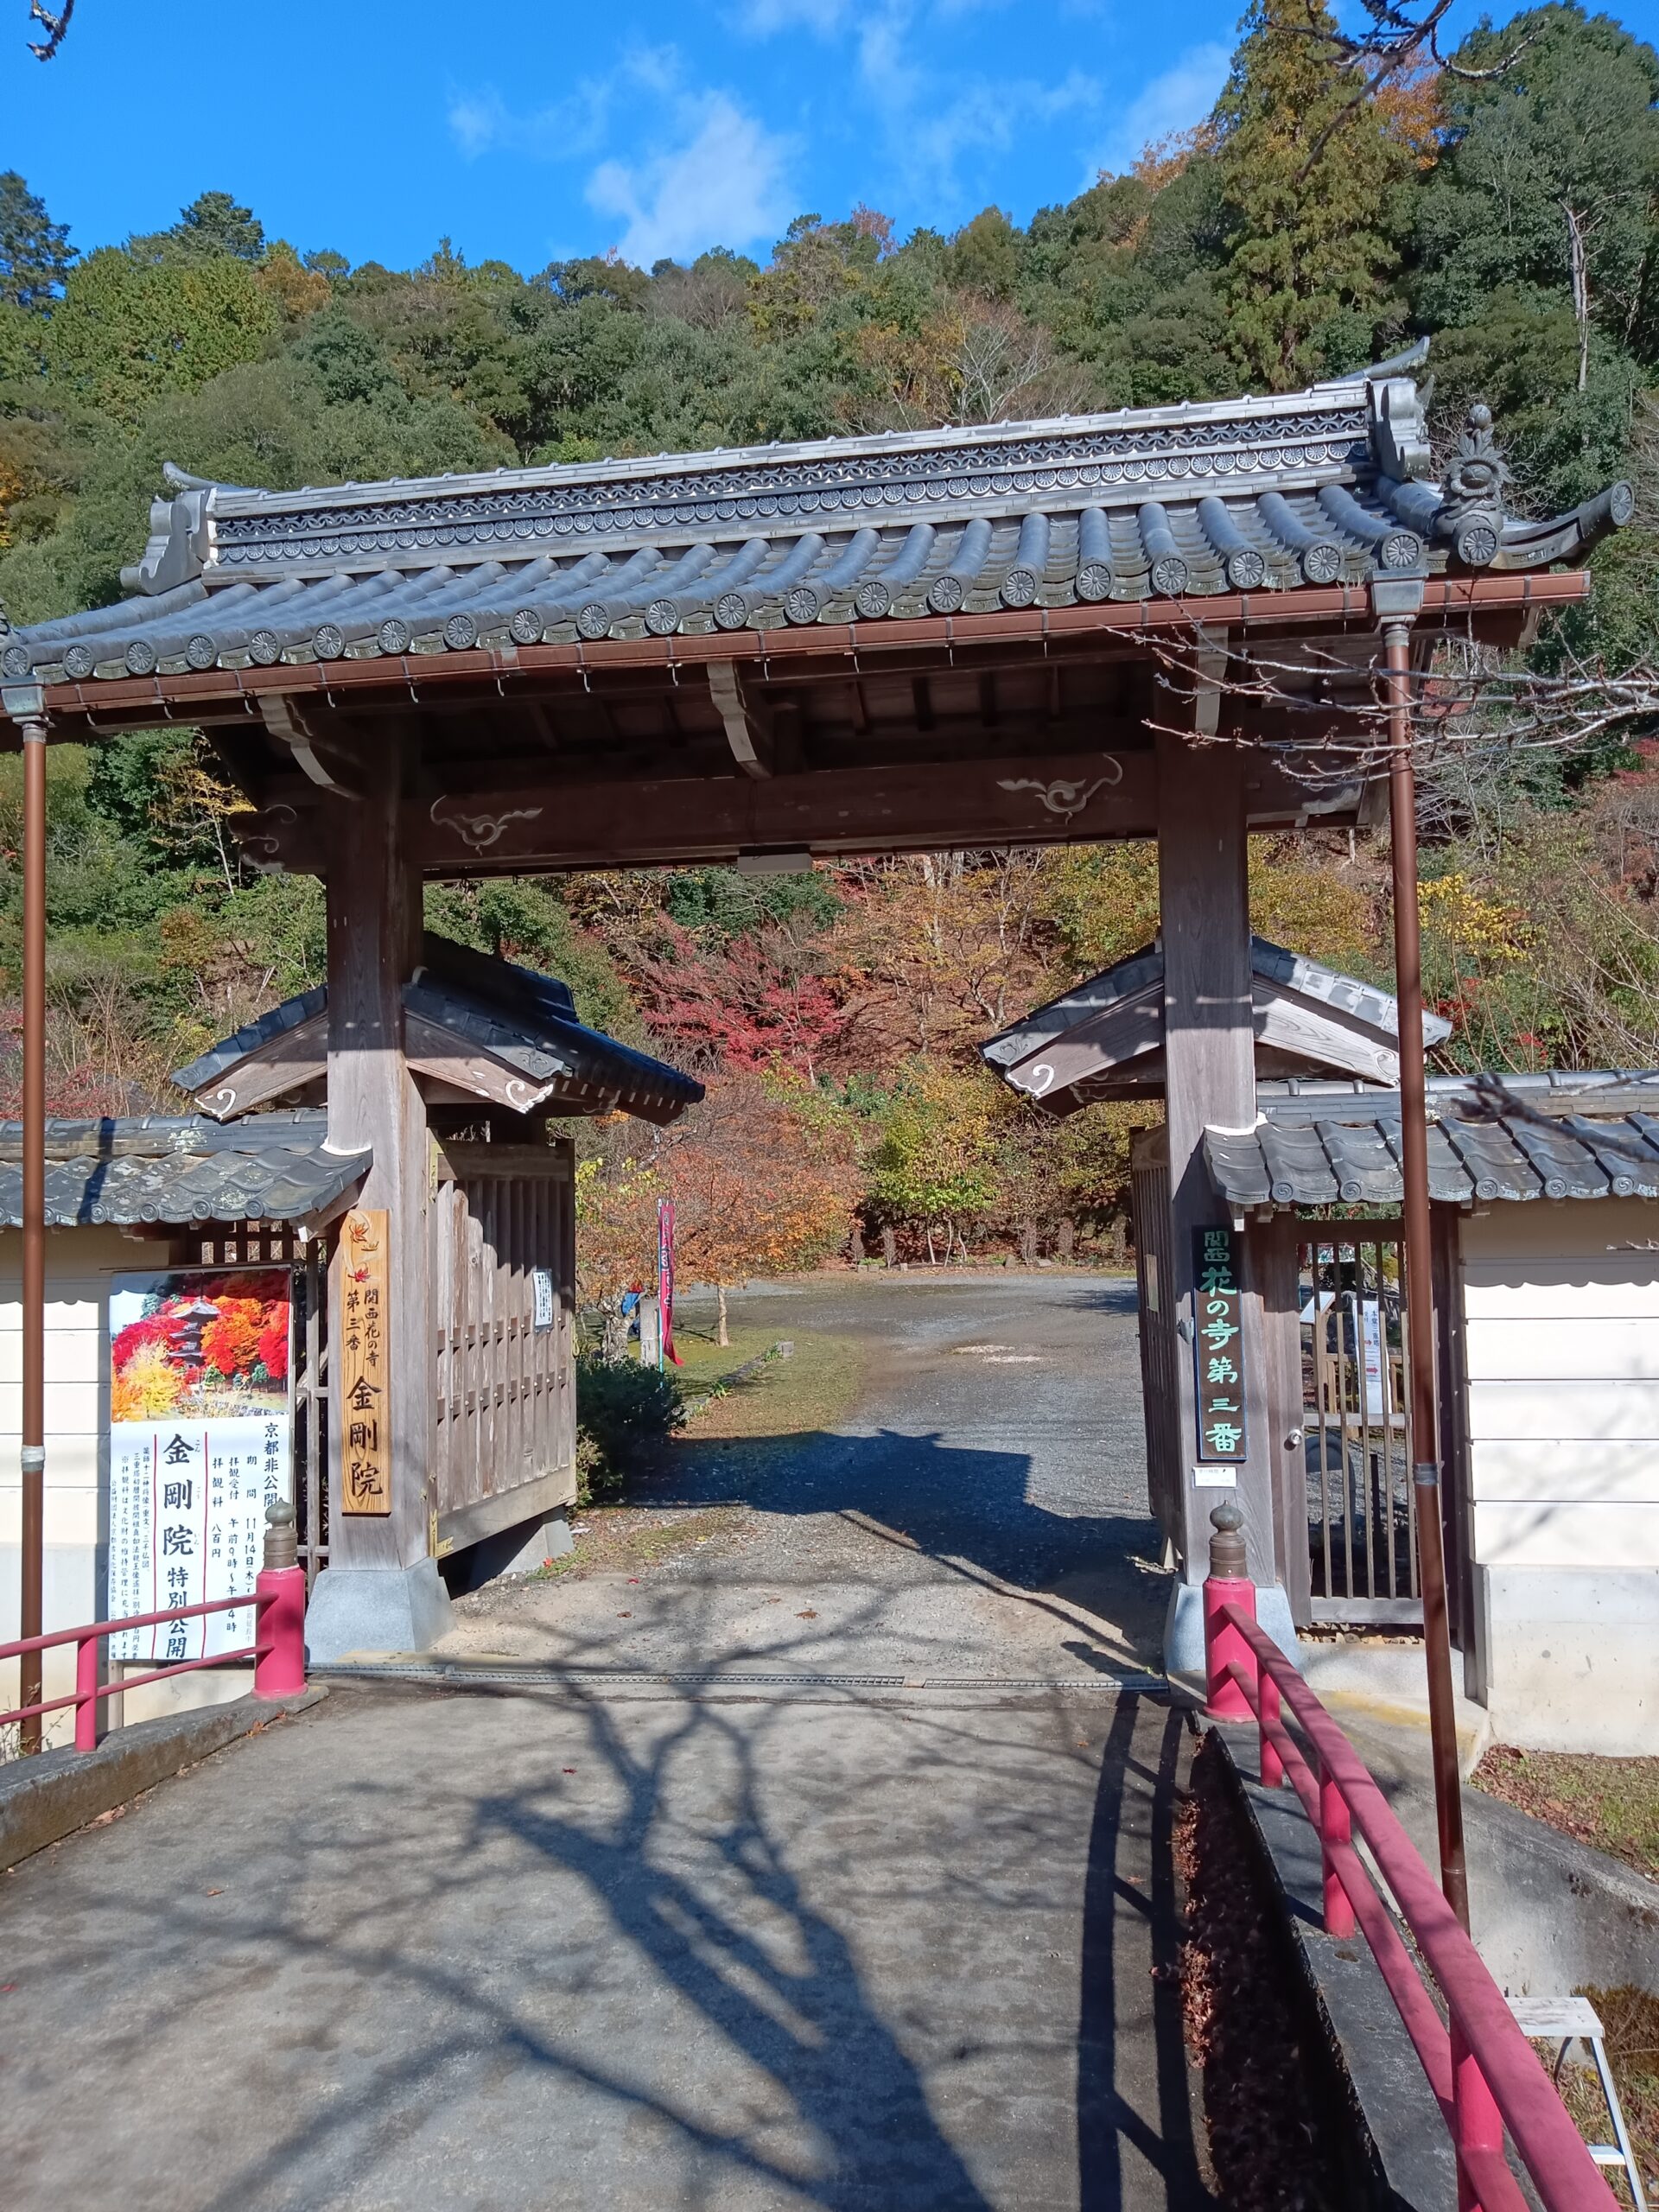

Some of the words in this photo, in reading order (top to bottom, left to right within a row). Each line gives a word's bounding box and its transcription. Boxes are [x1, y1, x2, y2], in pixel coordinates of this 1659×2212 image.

[346, 1289, 361, 1351] 第三番
[364, 1288, 380, 1367] 関西花の寺
[1200, 1230, 1243, 1452] 関西花の寺第三番
[346, 1376, 384, 1498] 金剛院
[212, 1457, 224, 1508] 拝観料
[229, 1457, 240, 1500] 拝観受付
[264, 1422, 279, 1526] 京都非公開
[212, 1523, 221, 1558] 八百円
